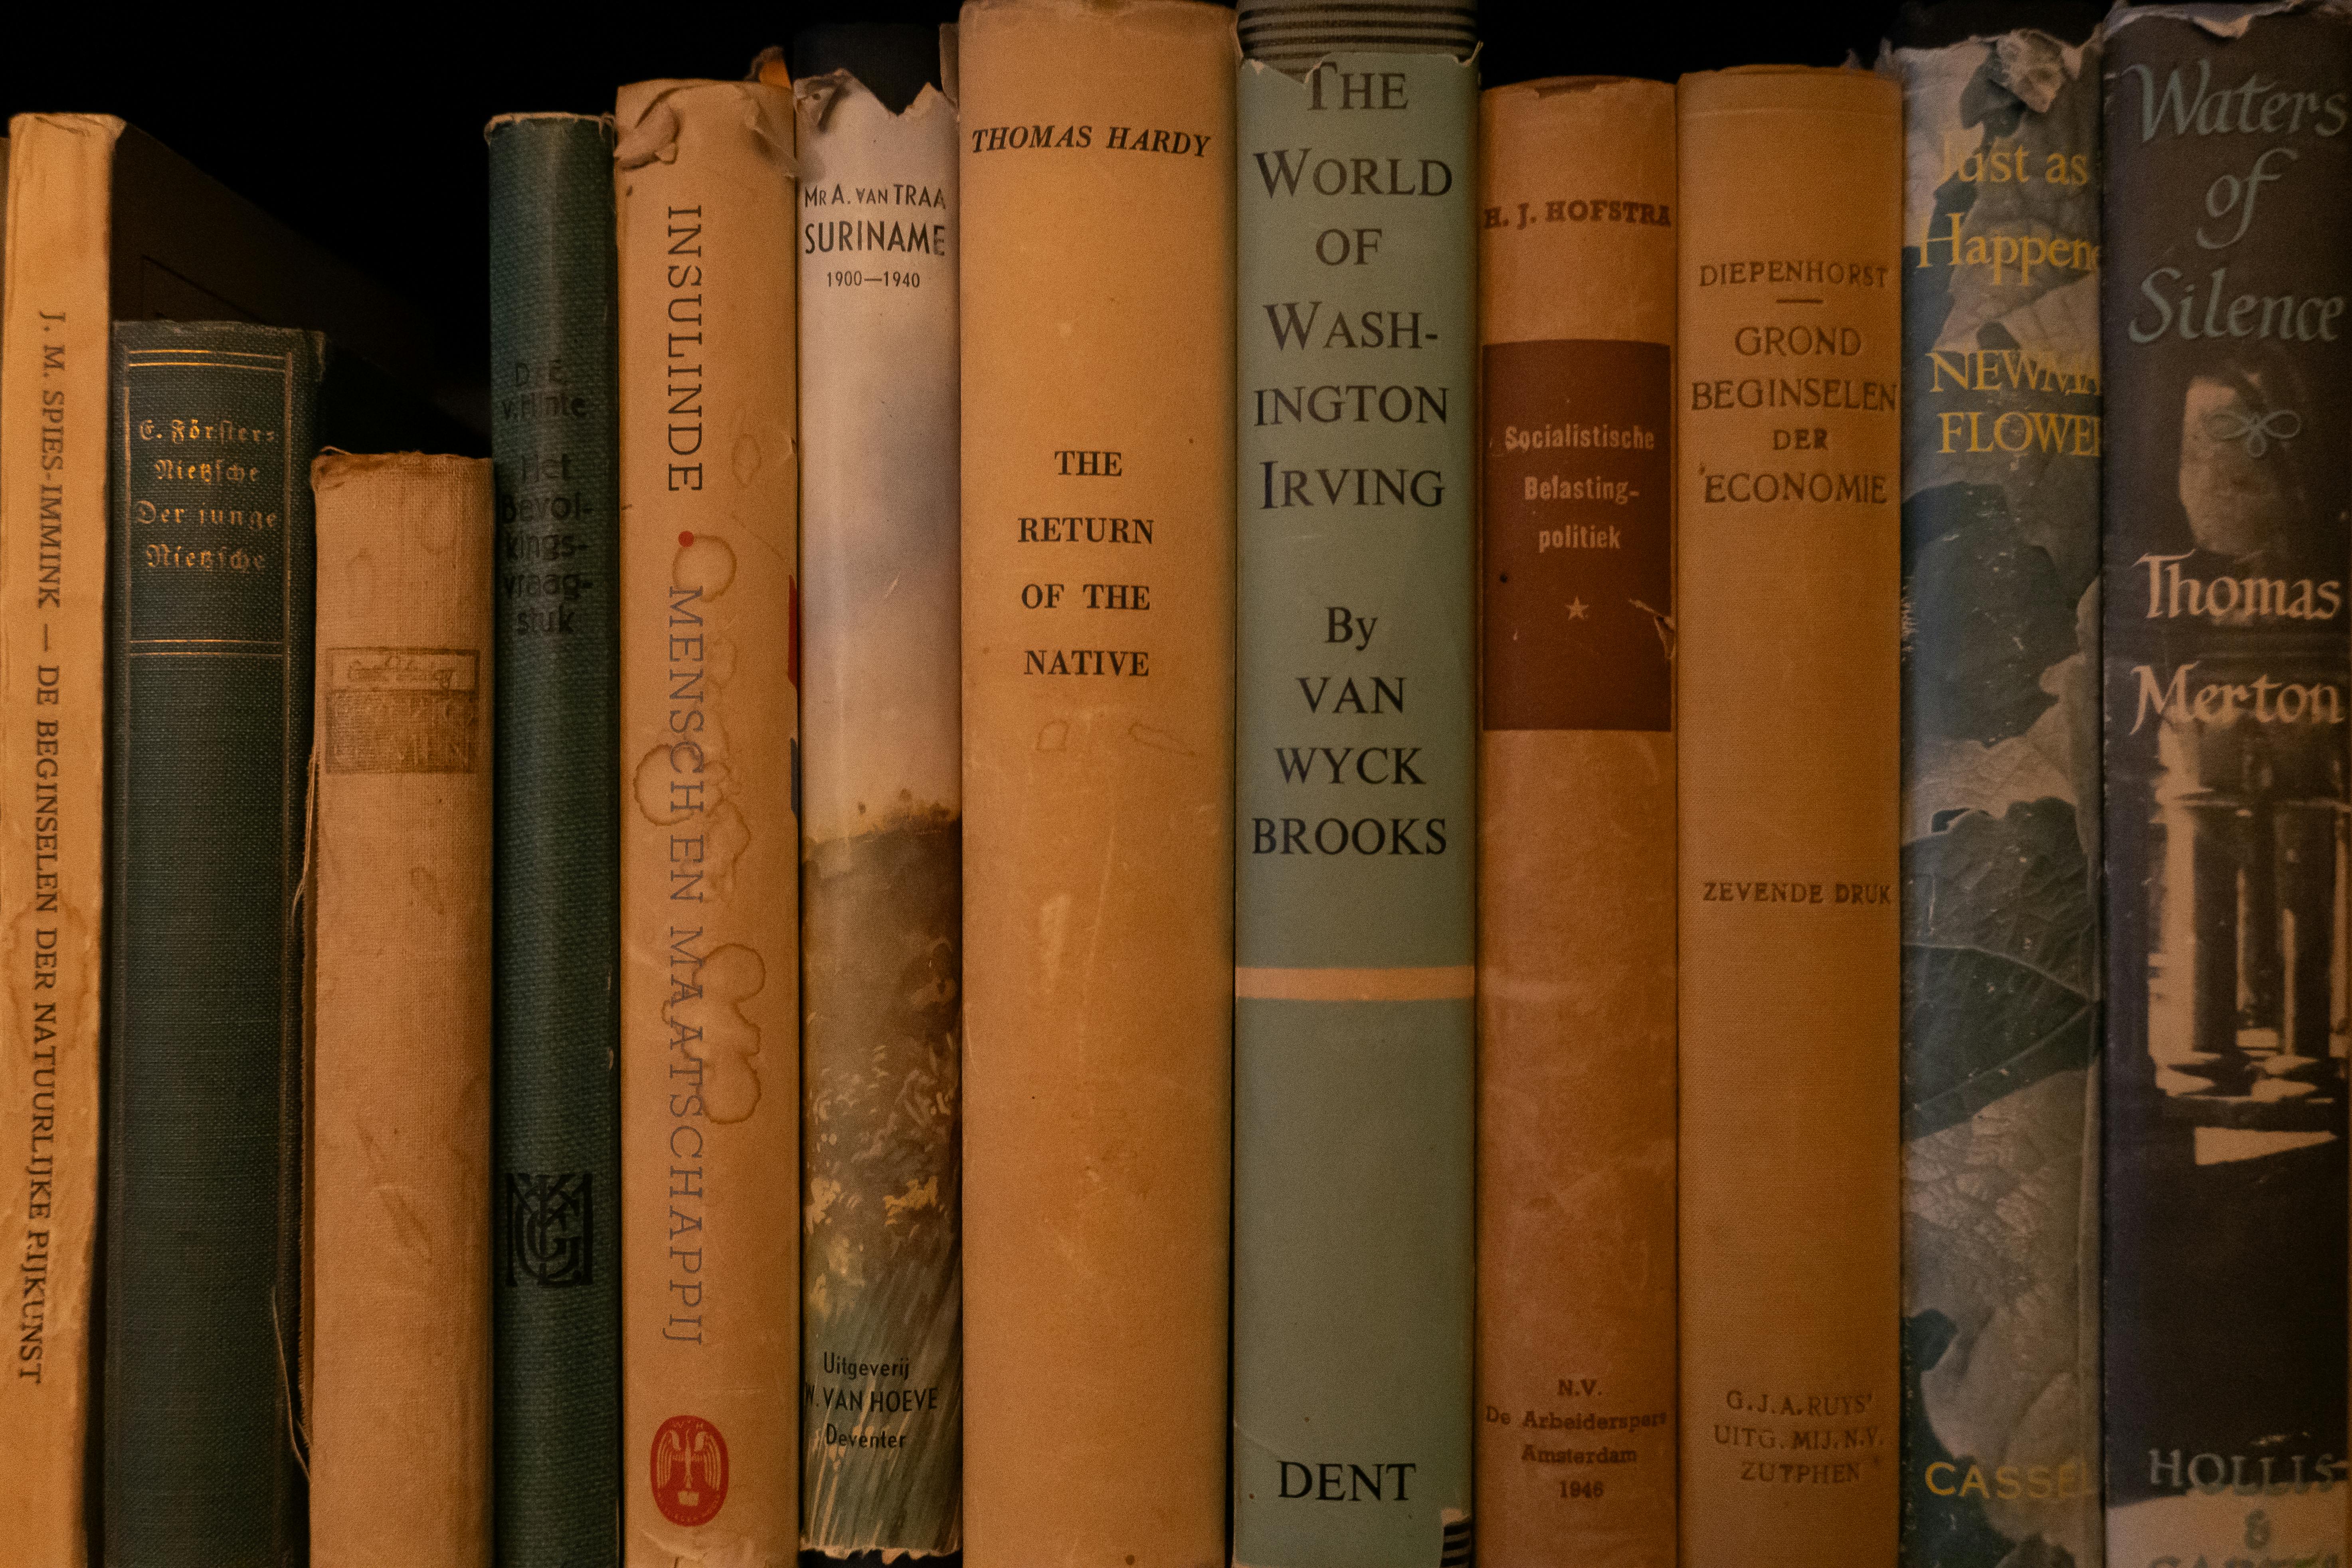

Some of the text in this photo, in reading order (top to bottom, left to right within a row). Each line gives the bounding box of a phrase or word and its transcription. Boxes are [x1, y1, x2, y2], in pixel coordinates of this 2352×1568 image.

[1306, 61, 1408, 111] THE
[2120, 57, 2348, 143] Waters
[972, 125, 1211, 157] THOMAS HARDY
[1253, 147, 1453, 199] WORLD
[2045, 152, 2089, 186] as
[832, 184, 851, 205] A.
[894, 184, 946, 209] TRAA
[2196, 148, 2299, 249] of
[1484, 200, 1672, 230] H. J. HOFSTRA
[805, 220, 945, 255] SURINAME
[1316, 228, 1383, 265] OF
[1699, 261, 1889, 287] DIEPENHORST
[39, 310, 66, 332] J.
[2128, 267, 2345, 344] Silence
[1263, 301, 1438, 351] WASH-
[1735, 326, 1861, 357] GROND
[43, 344, 66, 378] M.
[667, 204, 703, 491] INSULINDE
[1253, 385, 1450, 427] INGTON
[1692, 378, 1898, 412] BEGINSELEN
[1505, 423, 1654, 451] Socialistische
[1773, 429, 1828, 451] DER
[1054, 450, 1122, 477] THE
[38, 389, 65, 609] SPIES-IMMINK
[1259, 460, 1445, 509] IRVING
[1524, 475, 1639, 505] Belasting-
[1704, 473, 1887, 504] ECONOMIE
[135, 500, 185, 524] Der
[1017, 517, 1154, 544] RETURN
[1539, 524, 1621, 553] politiek
[1021, 583, 1150, 610] OF THE
[2131, 548, 2341, 620] Thomas
[1324, 606, 1377, 651] By
[1024, 650, 1149, 676] NATIVE
[37, 664, 60, 706] DE
[1298, 677, 1405, 714] VAN
[2128, 660, 2344, 736] Merton
[1275, 747, 1426, 785] WYCK
[35, 720, 59, 913] BEGINSELEN
[1252, 818, 1447, 855] BROOKS
[1702, 882, 1891, 905] ZEVENDE DRUK
[34, 928, 57, 991] DER
[663, 585, 704, 1345] MENSCH EN MAATSCHAPPIJ
[26, 1002, 56, 1220] NATUURLIJKE
[824, 1352, 909, 1380] Uitgeverij
[823, 1387, 862, 1411] VAN
[870, 1387, 938, 1412] HOEVE
[1558, 1379, 1602, 1396] N.V.
[1486, 1405, 1511, 1425] De
[826, 1423, 906, 1448] Deventer
[1521, 1444, 1636, 1464] Amsterdam
[1277, 1460, 1416, 1501] DENT
[1741, 1461, 1861, 1484] ZUTPHEN
[2148, 1449, 2334, 1496] HOLLIS
